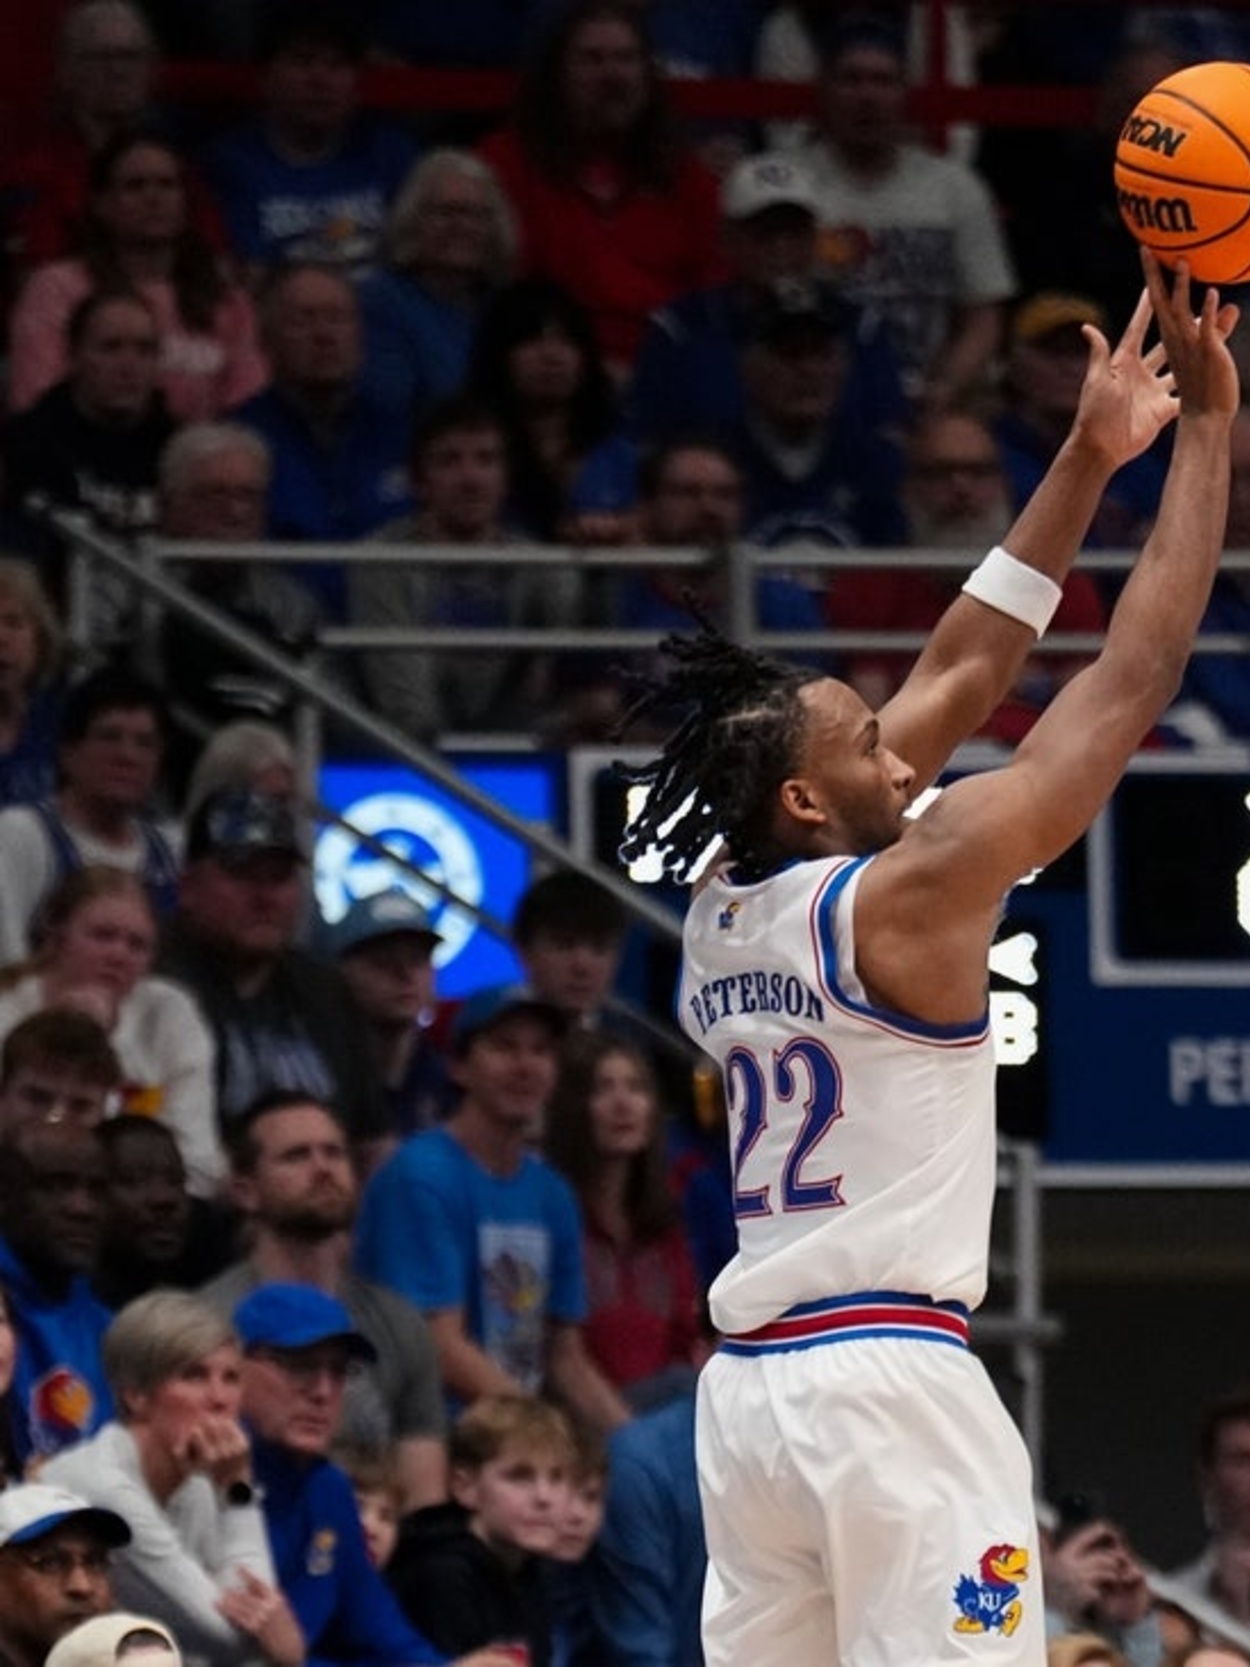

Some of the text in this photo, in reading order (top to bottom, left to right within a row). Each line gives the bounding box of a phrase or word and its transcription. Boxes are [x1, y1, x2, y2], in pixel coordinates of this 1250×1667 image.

[690, 971, 824, 1035] PETERSON
[726, 1036, 847, 1219] 22
[980, 1592, 1002, 1611] KU
